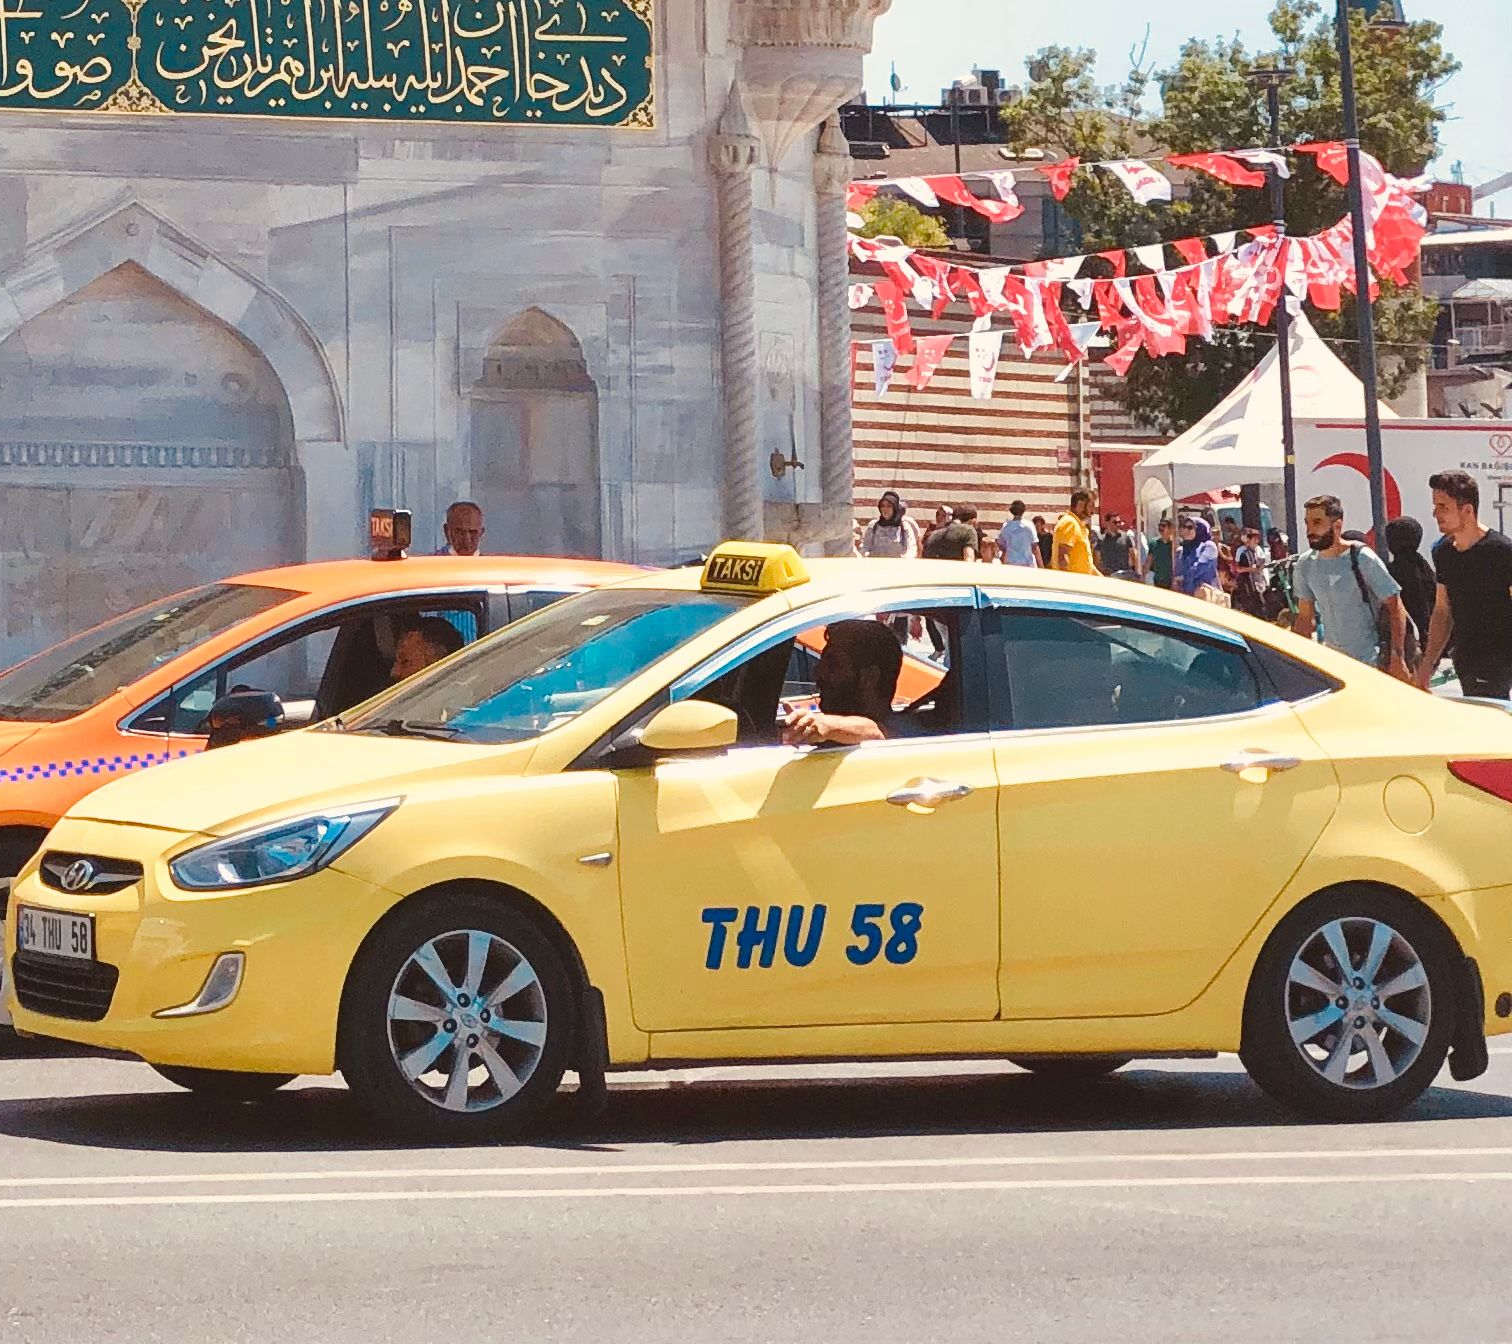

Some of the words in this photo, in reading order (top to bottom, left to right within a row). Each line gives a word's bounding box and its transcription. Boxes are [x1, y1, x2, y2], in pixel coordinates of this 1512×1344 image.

[23, 913, 36, 946] 34
[41, 916, 62, 951] THU
[71, 920, 88, 954] 58
[701, 904, 827, 970] THU
[845, 902, 925, 966] 58
